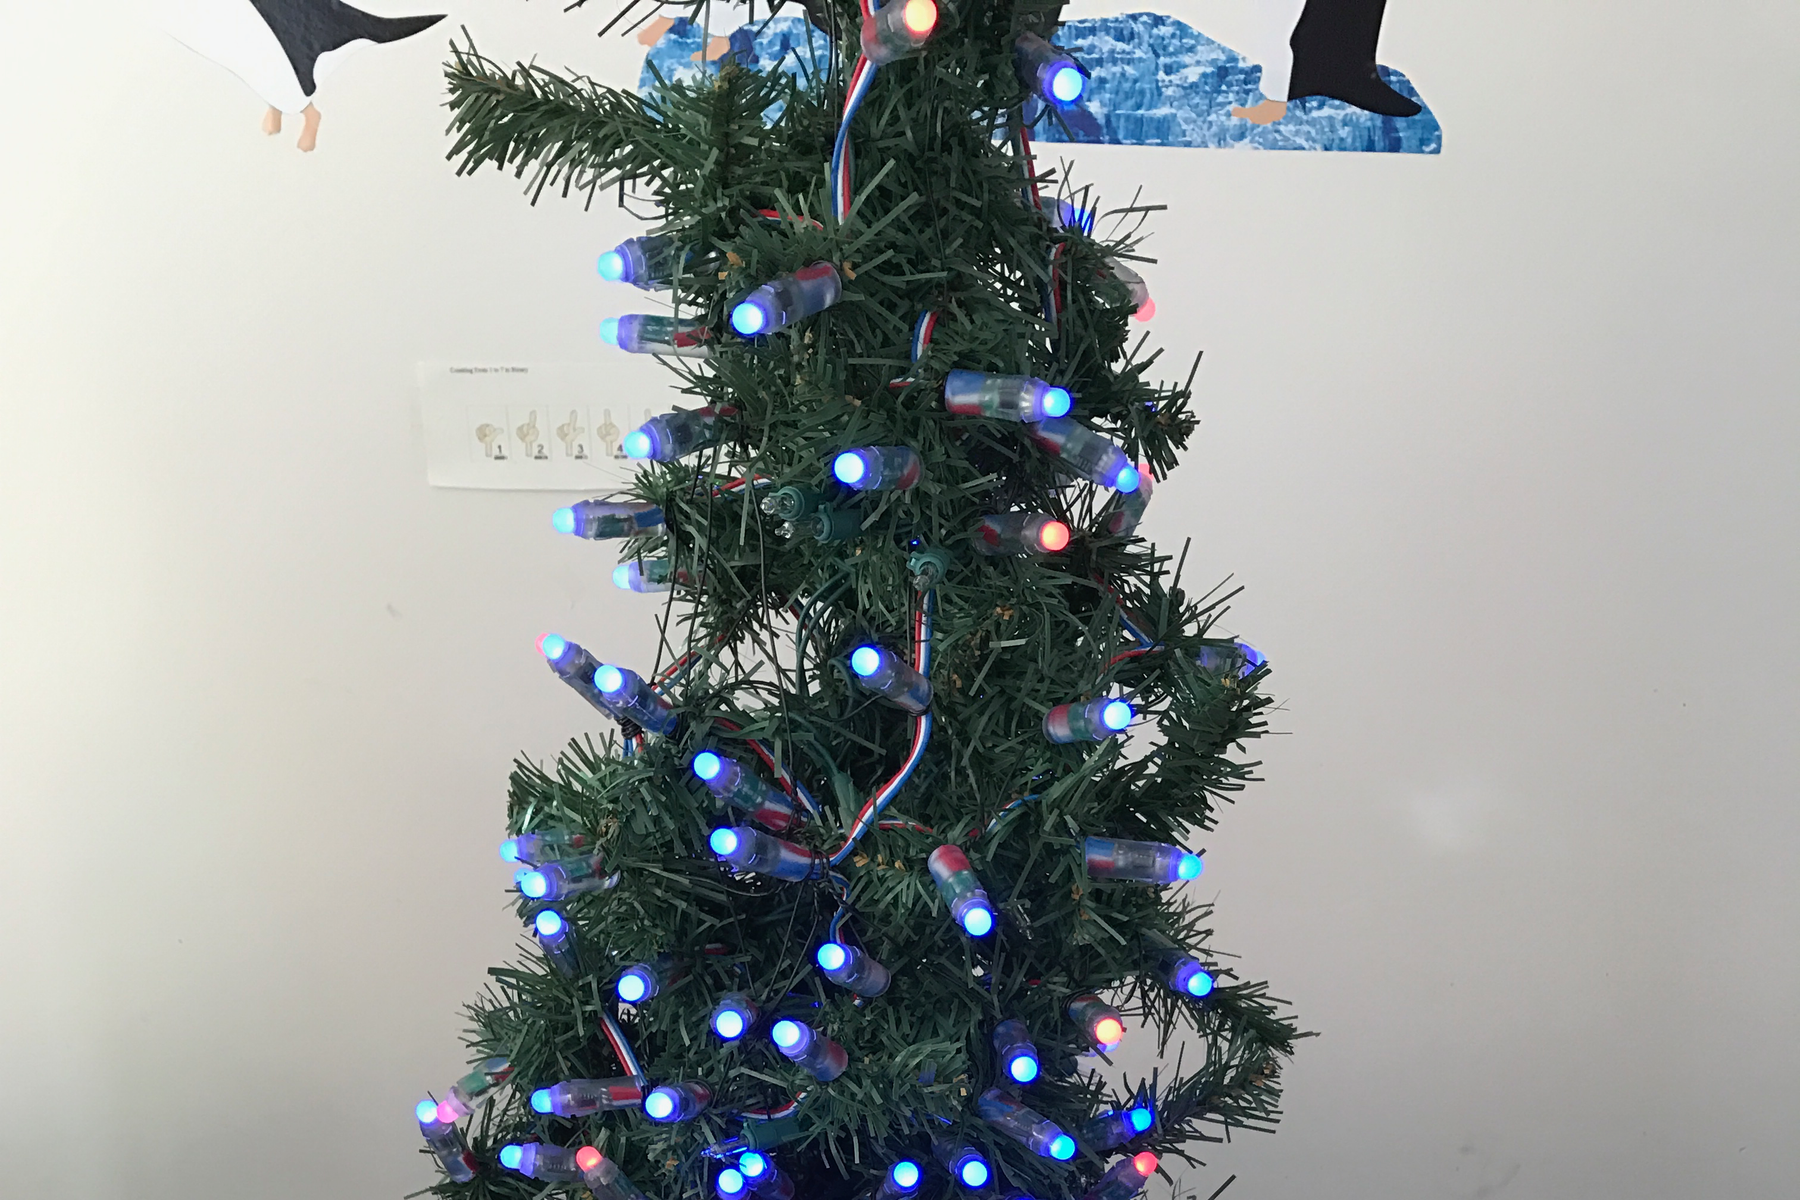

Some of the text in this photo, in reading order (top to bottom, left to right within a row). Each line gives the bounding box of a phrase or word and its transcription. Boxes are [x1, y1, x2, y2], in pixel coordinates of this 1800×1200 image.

[497, 444, 502, 454] 1
[537, 444, 545, 454] 2
[577, 444, 584, 454] 3
[616, 444, 624, 454] 4
